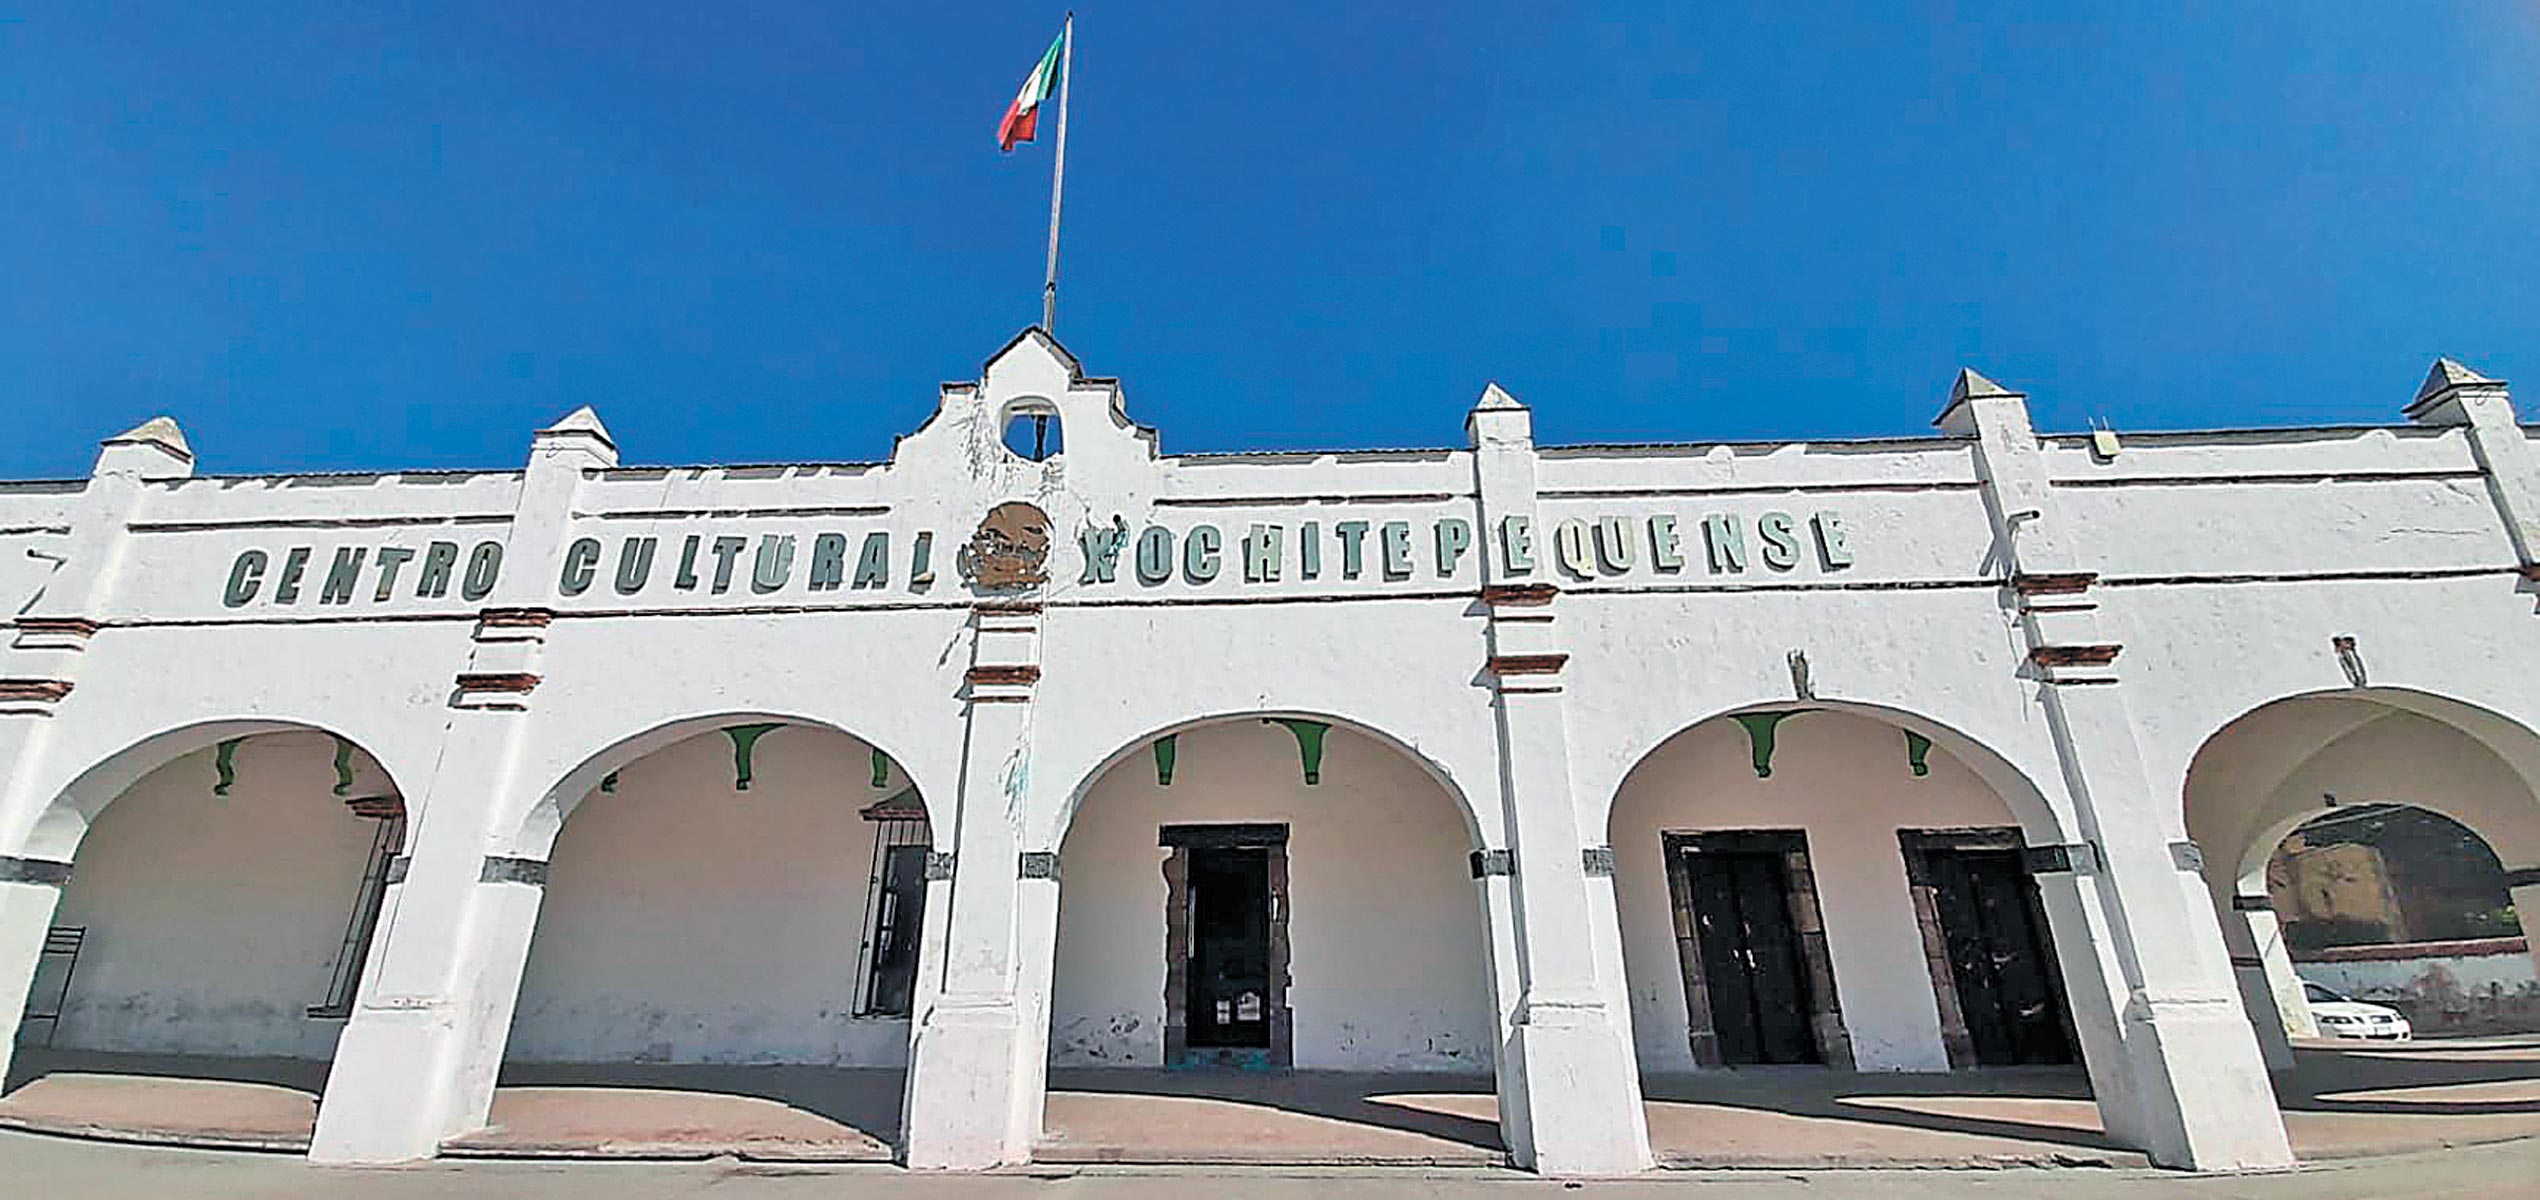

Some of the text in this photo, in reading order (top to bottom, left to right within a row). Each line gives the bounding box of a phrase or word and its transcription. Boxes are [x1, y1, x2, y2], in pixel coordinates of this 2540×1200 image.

[223, 511, 1854, 608] CENTRO CULTURAL XOCHITEPEQUENSE
